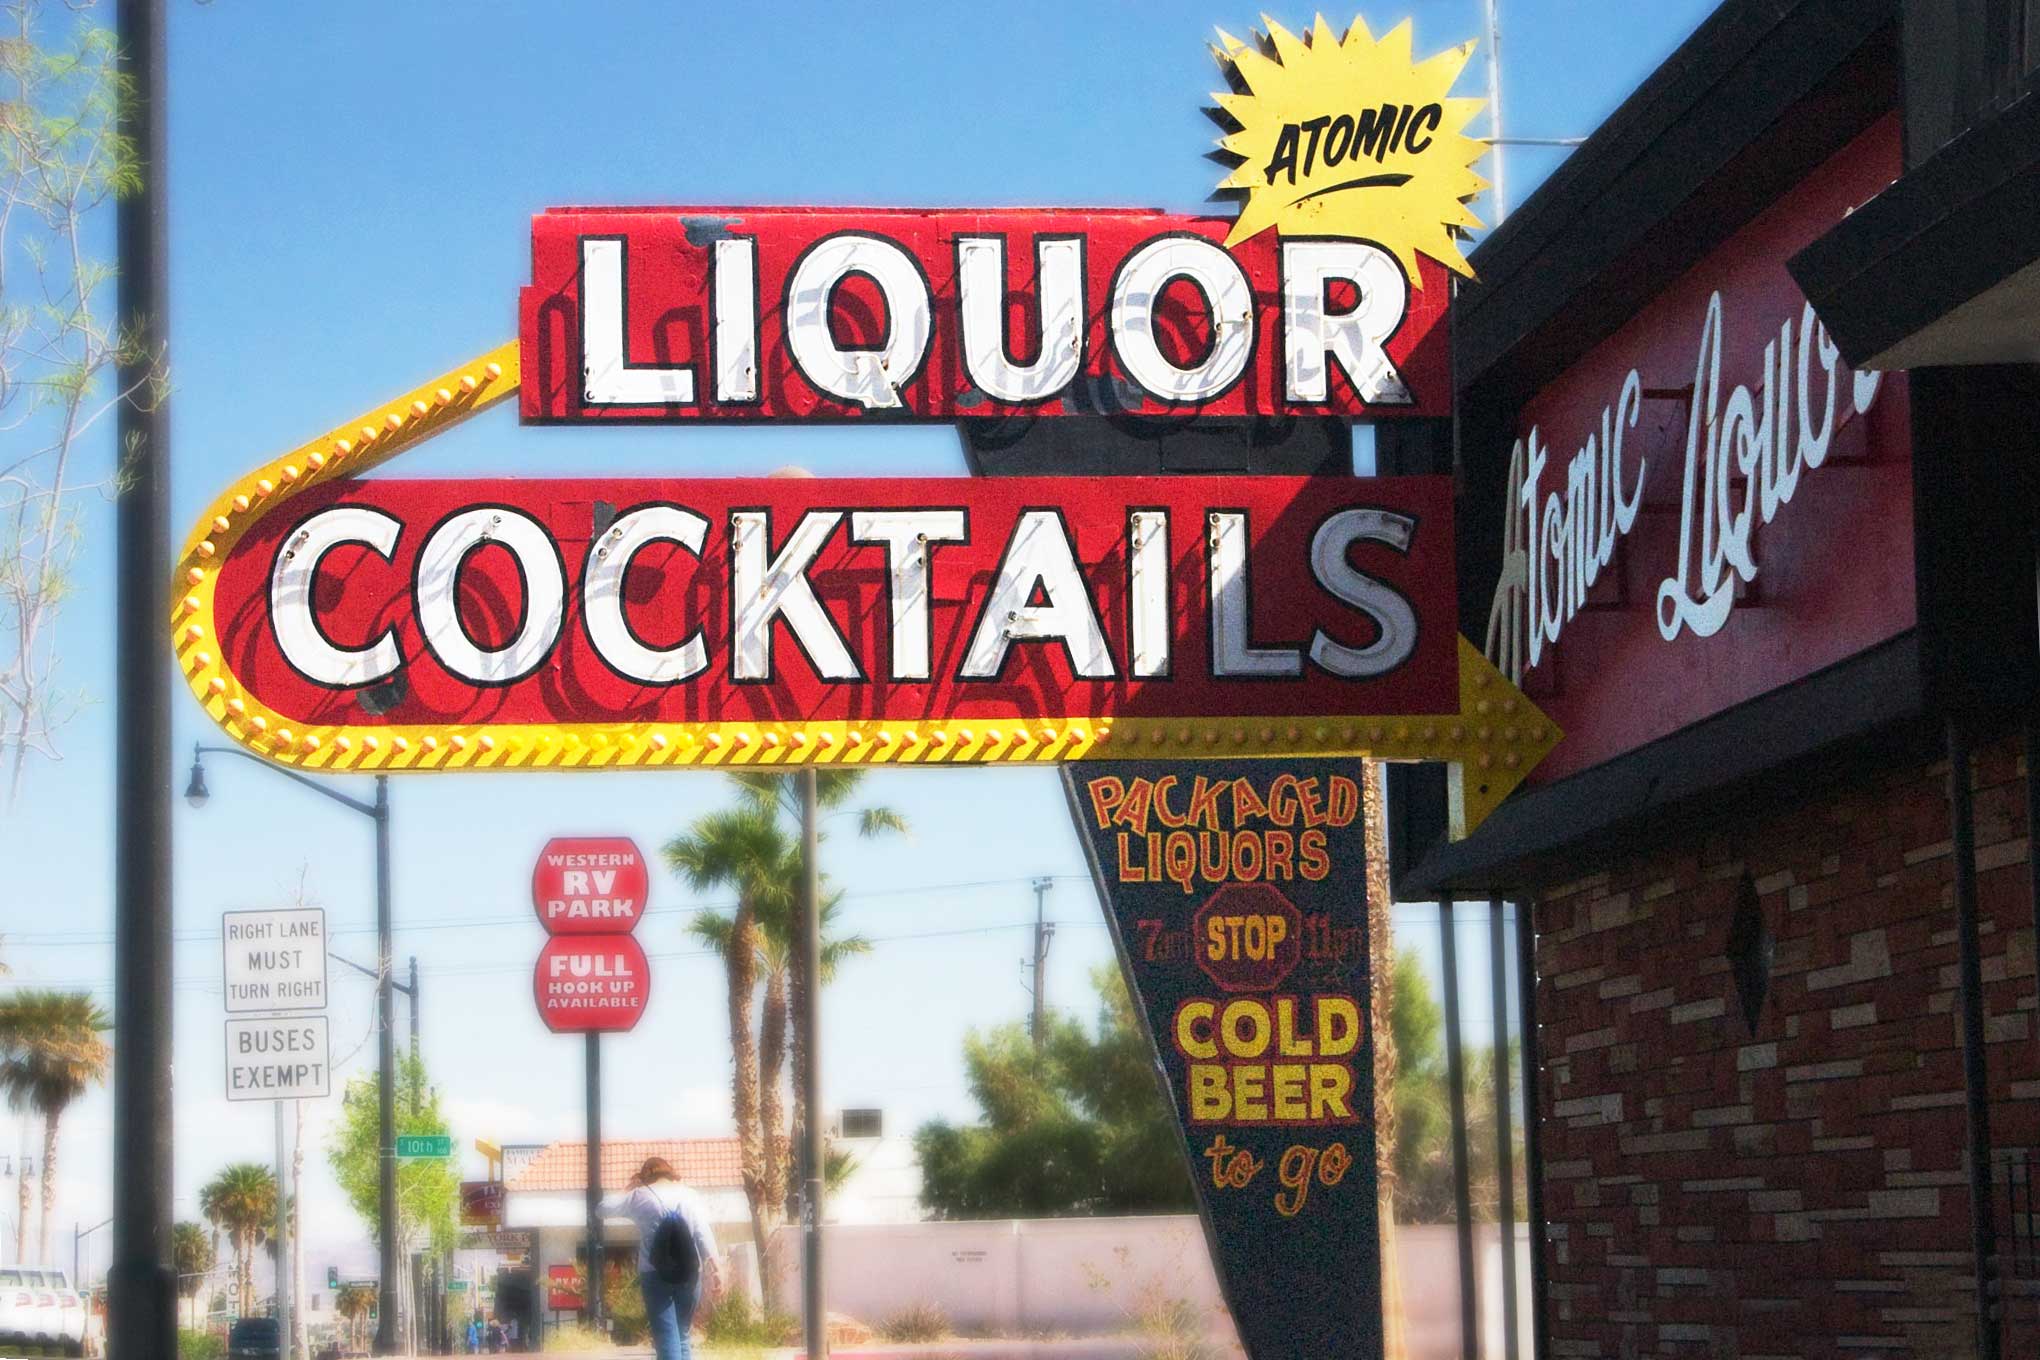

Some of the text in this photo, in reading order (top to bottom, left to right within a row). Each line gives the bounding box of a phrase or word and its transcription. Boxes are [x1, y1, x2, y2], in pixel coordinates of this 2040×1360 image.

[1263, 102, 1443, 186] ATOMIC
[580, 232, 1412, 410] LIQUOR
[1485, 290, 1880, 690] Atomic Liquo
[270, 505, 1419, 685] COCKTAILS
[1087, 773, 1358, 836] PACKAGED
[548, 854, 635, 867] WESTERN
[1116, 830, 1331, 893] LIQUORS
[563, 870, 617, 896] RV
[548, 899, 634, 918] PARK
[229, 921, 320, 941] RIGHT LANE
[1207, 914, 1287, 962] STOP
[248, 950, 303, 971] MUST
[550, 955, 633, 978] FULL
[230, 980, 321, 1000] TURN RIGHT
[548, 980, 635, 995] HOOK UP
[547, 996, 639, 1009] AVAILABLE
[1176, 997, 1360, 1058] COLD
[239, 1028, 316, 1054] BUSES
[232, 1063, 323, 1089] EXEMPT
[1190, 1063, 1351, 1122] BEER
[408, 1140, 433, 1153] 10th
[1204, 1134, 1352, 1217] to go
